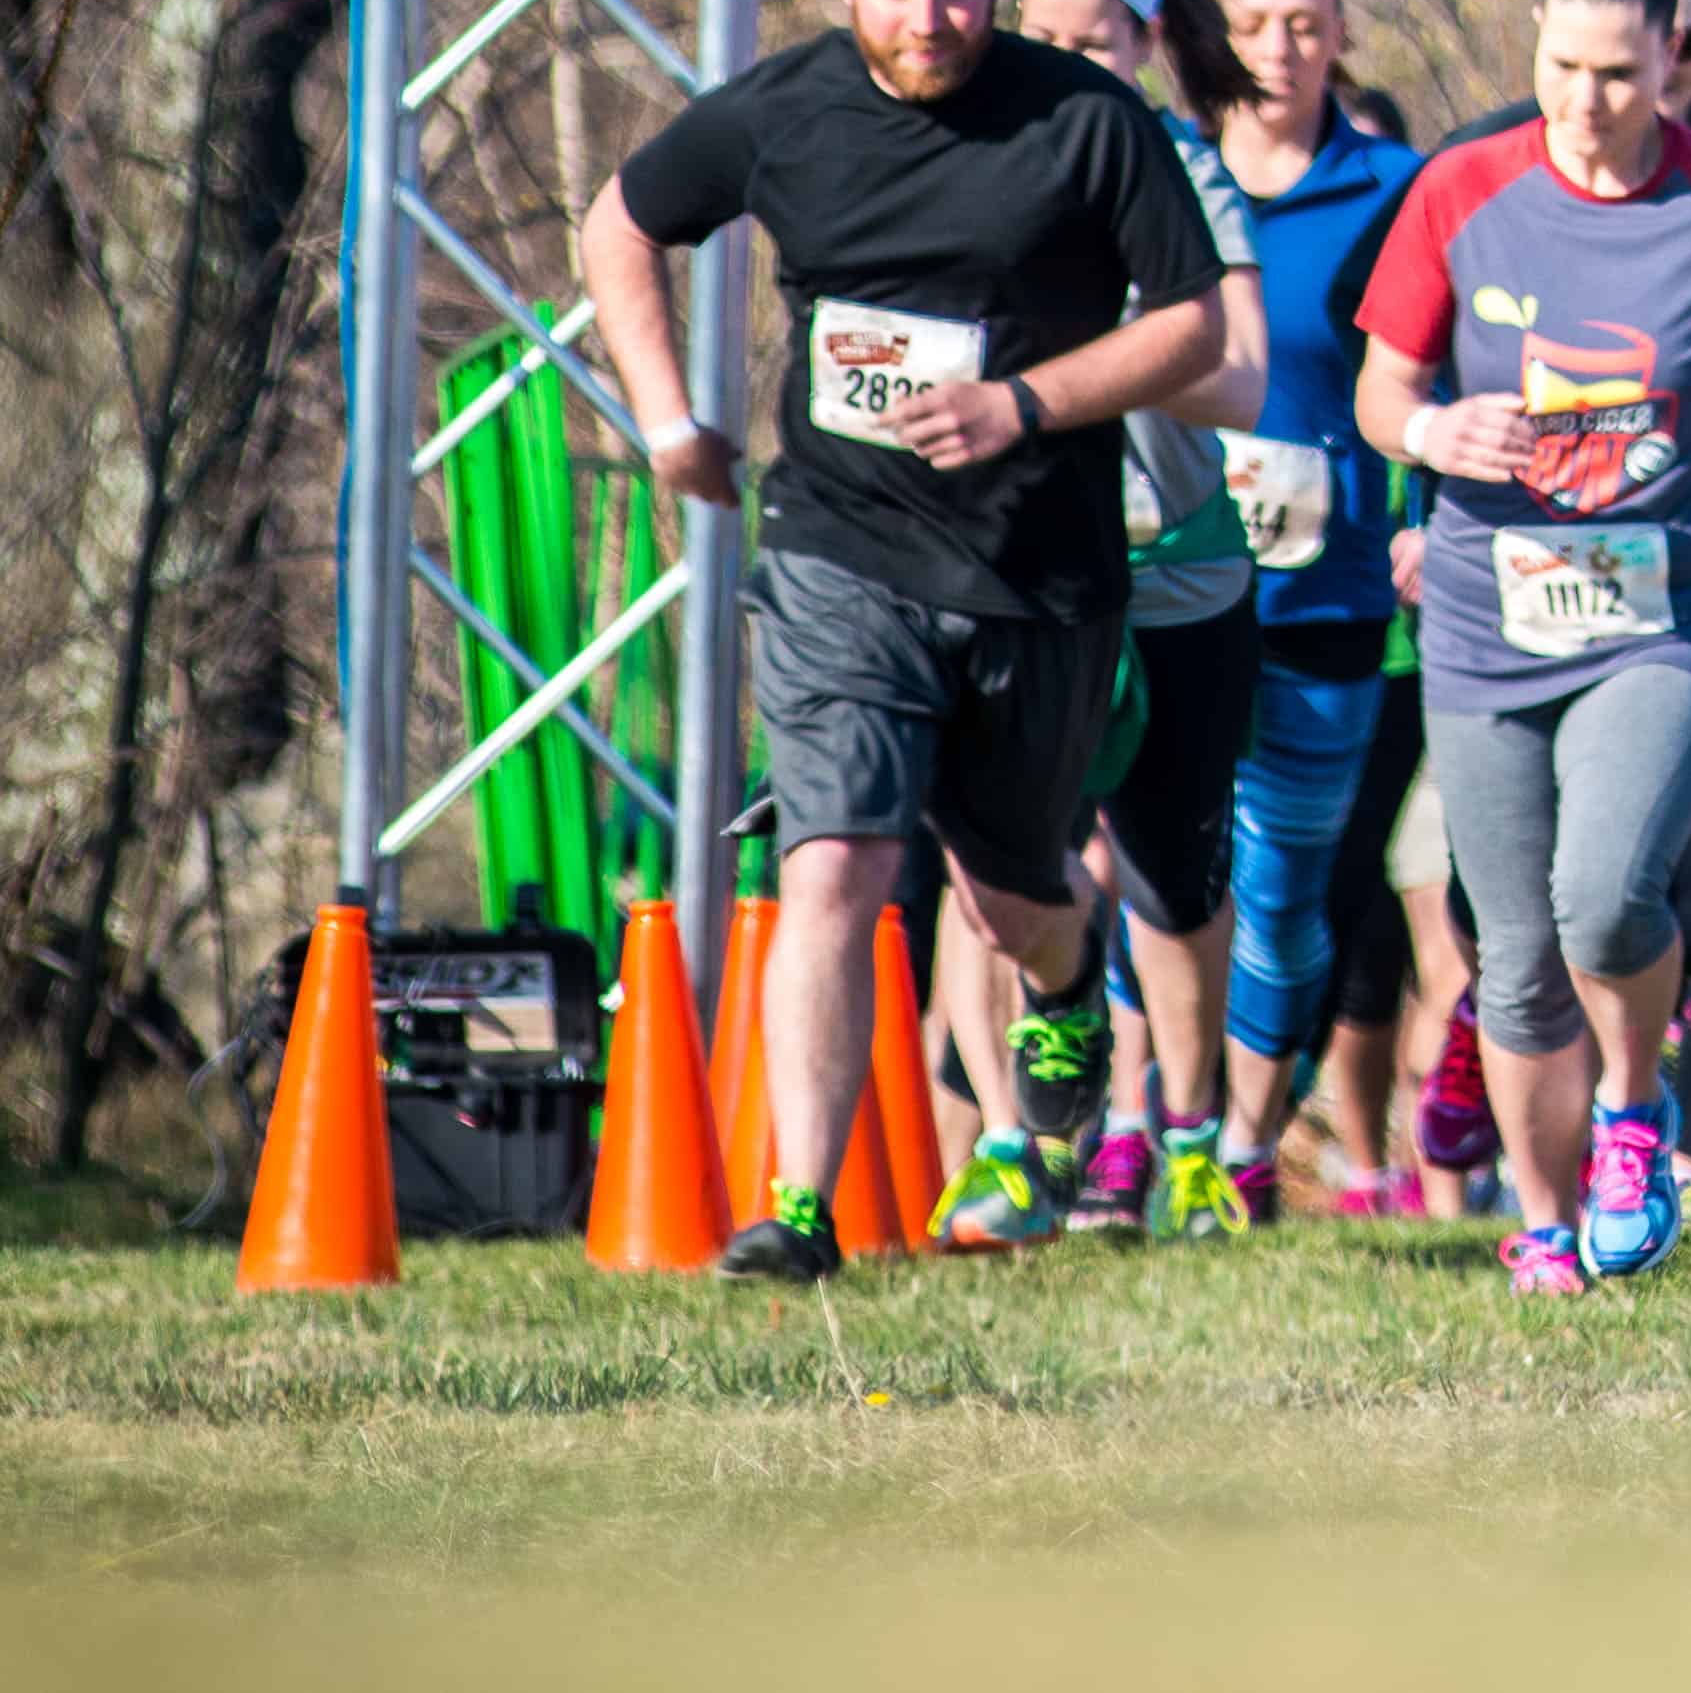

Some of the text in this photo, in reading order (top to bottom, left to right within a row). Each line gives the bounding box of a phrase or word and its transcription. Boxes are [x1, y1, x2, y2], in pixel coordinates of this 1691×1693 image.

[1580, 401, 1655, 435] CIDER
[1514, 432, 1640, 514] RUN
[1544, 576, 1625, 616] 11172
